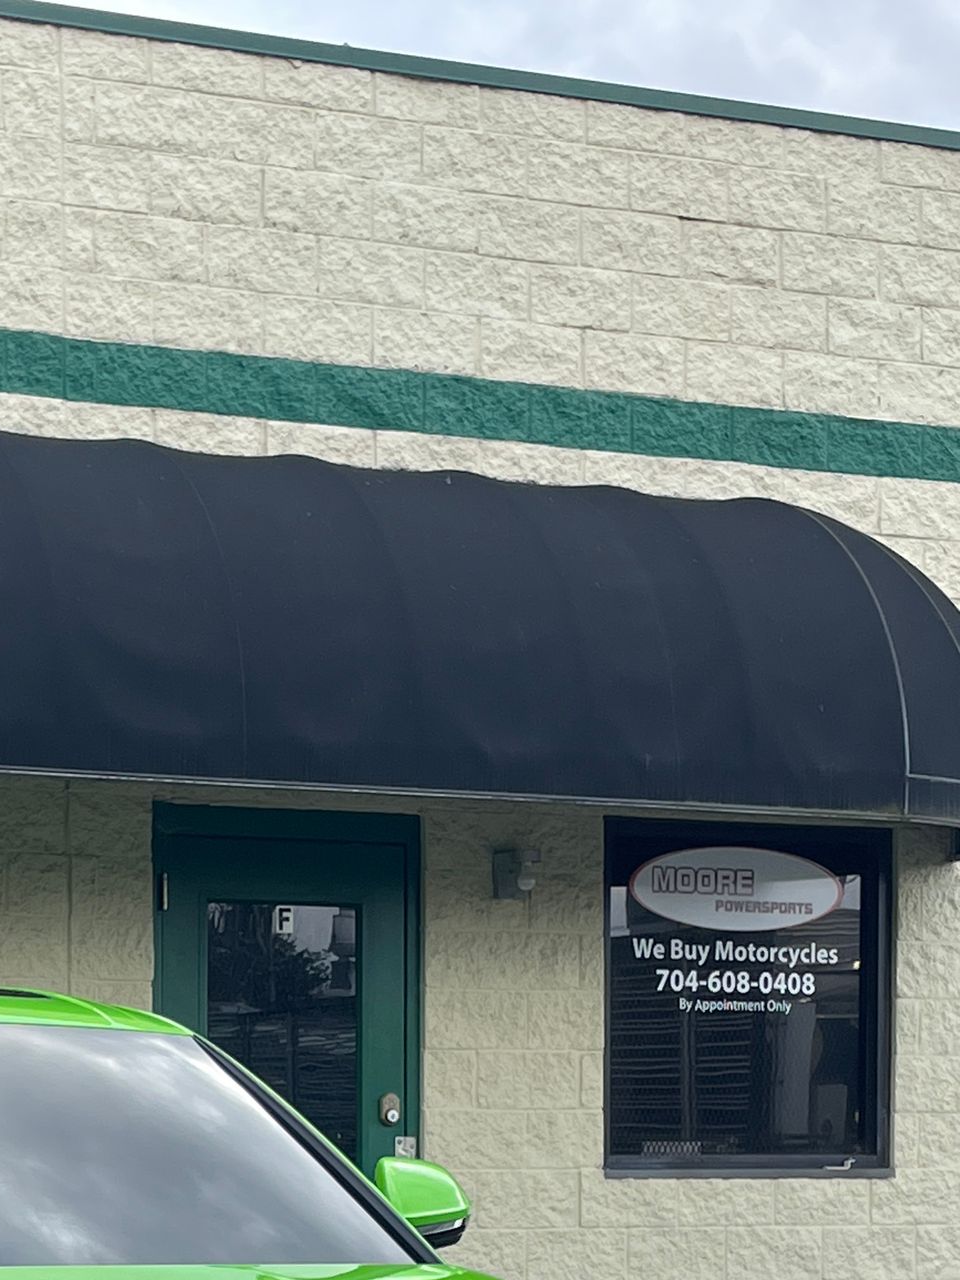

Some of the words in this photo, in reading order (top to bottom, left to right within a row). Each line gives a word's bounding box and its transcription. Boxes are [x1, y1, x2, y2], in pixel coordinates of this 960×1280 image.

[651, 866, 754, 897] MOORE
[278, 907, 292, 931] F
[715, 900, 814, 915] POWERSPORTS
[632, 937, 665, 960] We
[670, 938, 710, 966] Buy
[714, 940, 839, 968] Motorcycles
[655, 969, 816, 996] 704-608-0408
[679, 998, 693, 1012] By
[694, 999, 766, 1014] Appointment
[767, 1000, 792, 1014] Only
